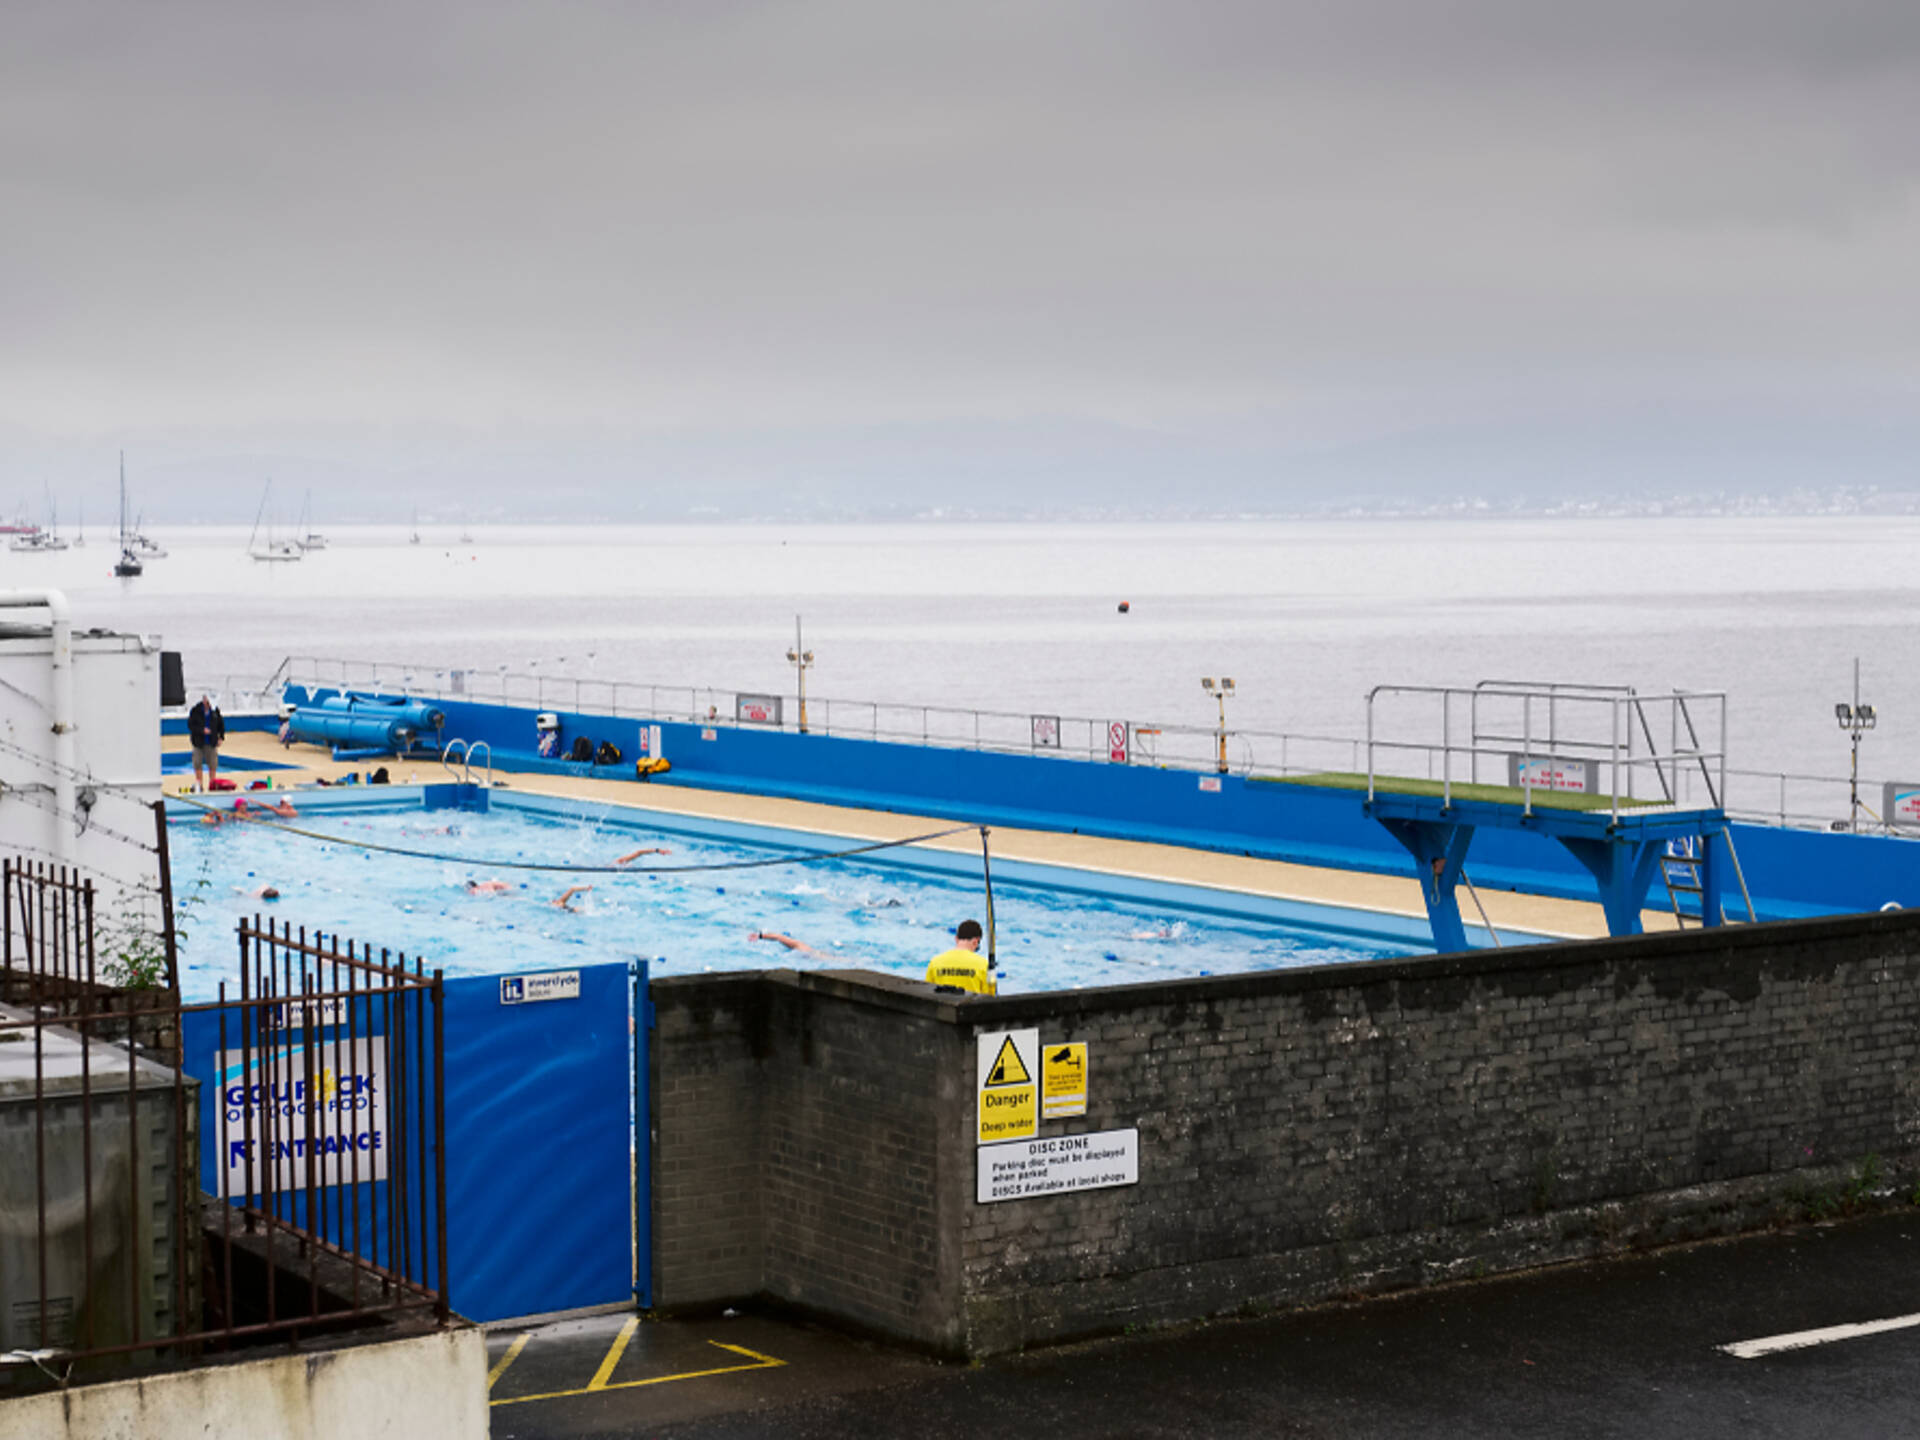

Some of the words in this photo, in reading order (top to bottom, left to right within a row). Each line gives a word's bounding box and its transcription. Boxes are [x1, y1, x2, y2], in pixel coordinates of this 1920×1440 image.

[986, 1094, 1030, 1108] Danger
[1029, 1142, 1056, 1155] DISC
[1059, 1138, 1089, 1152] ZONE
[992, 1160, 1026, 1172] Parking
[1028, 1158, 1046, 1168] disc
[1048, 1155, 1069, 1165] must
[1072, 1152, 1082, 1162] be
[1085, 1147, 1125, 1161] displayed
[992, 1173, 1015, 1183] when
[1018, 1168, 1048, 1181] parked
[992, 1184, 1022, 1196] DISCS
[1067, 1177, 1076, 1187] at
